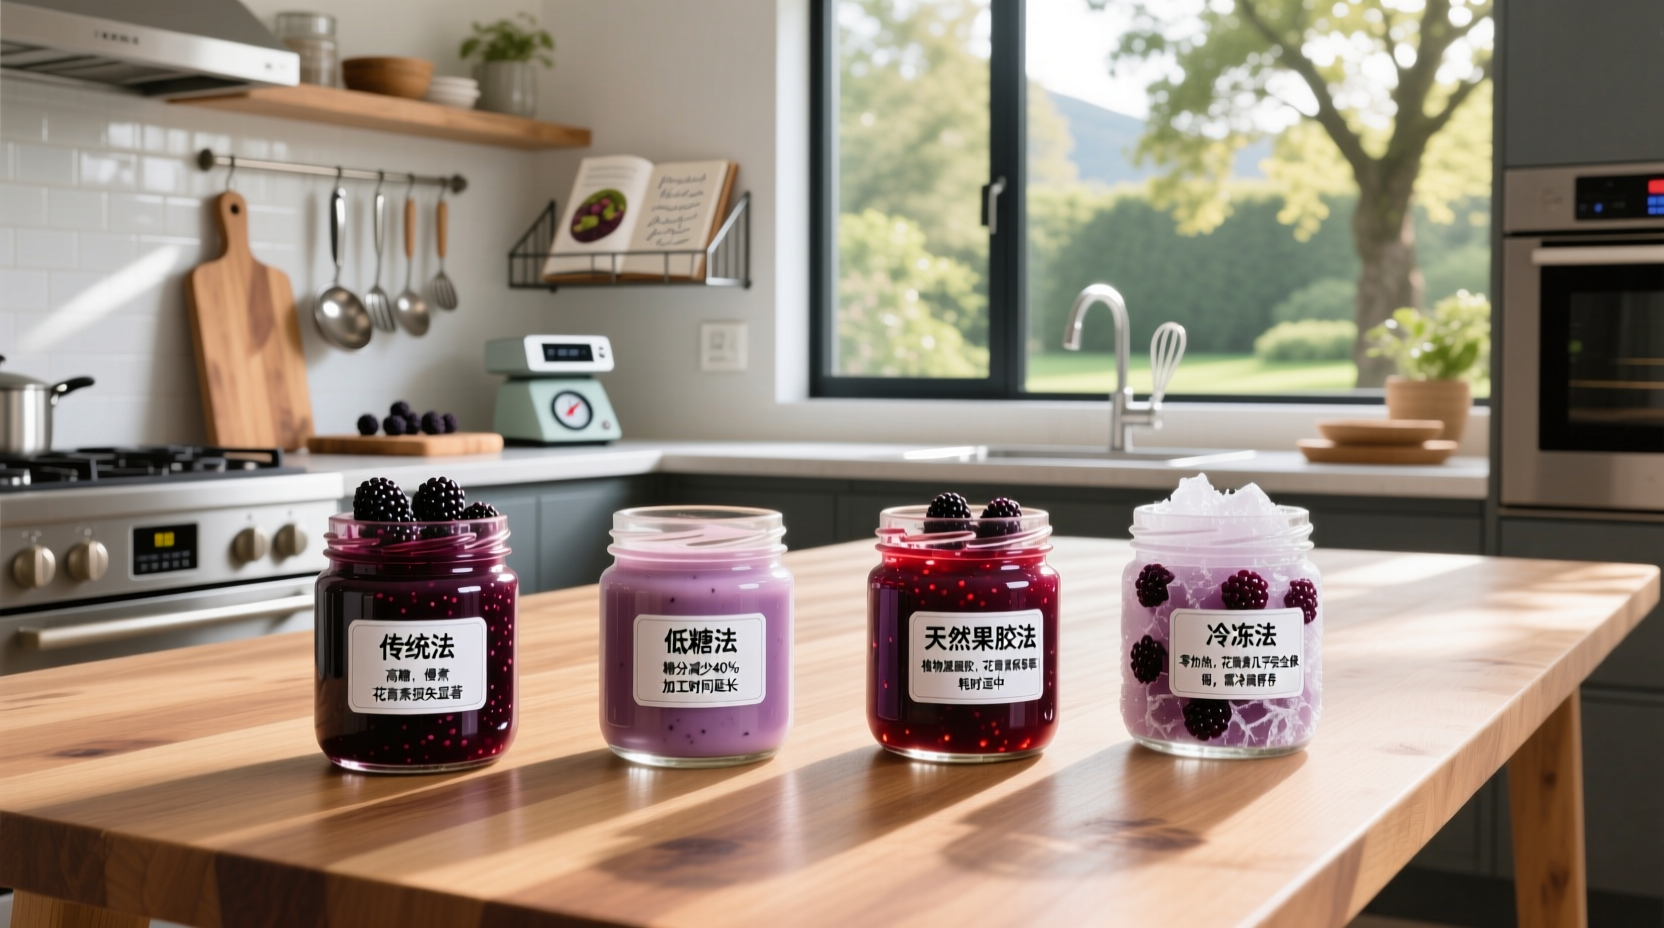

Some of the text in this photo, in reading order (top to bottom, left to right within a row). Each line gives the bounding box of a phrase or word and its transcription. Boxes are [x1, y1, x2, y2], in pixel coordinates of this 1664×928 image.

[379, 632, 455, 661] 传统法
[664, 627, 738, 655] 低糖法
[925, 623, 1037, 652] 天然果胶法
[1206, 622, 1277, 648] 冷冻法
